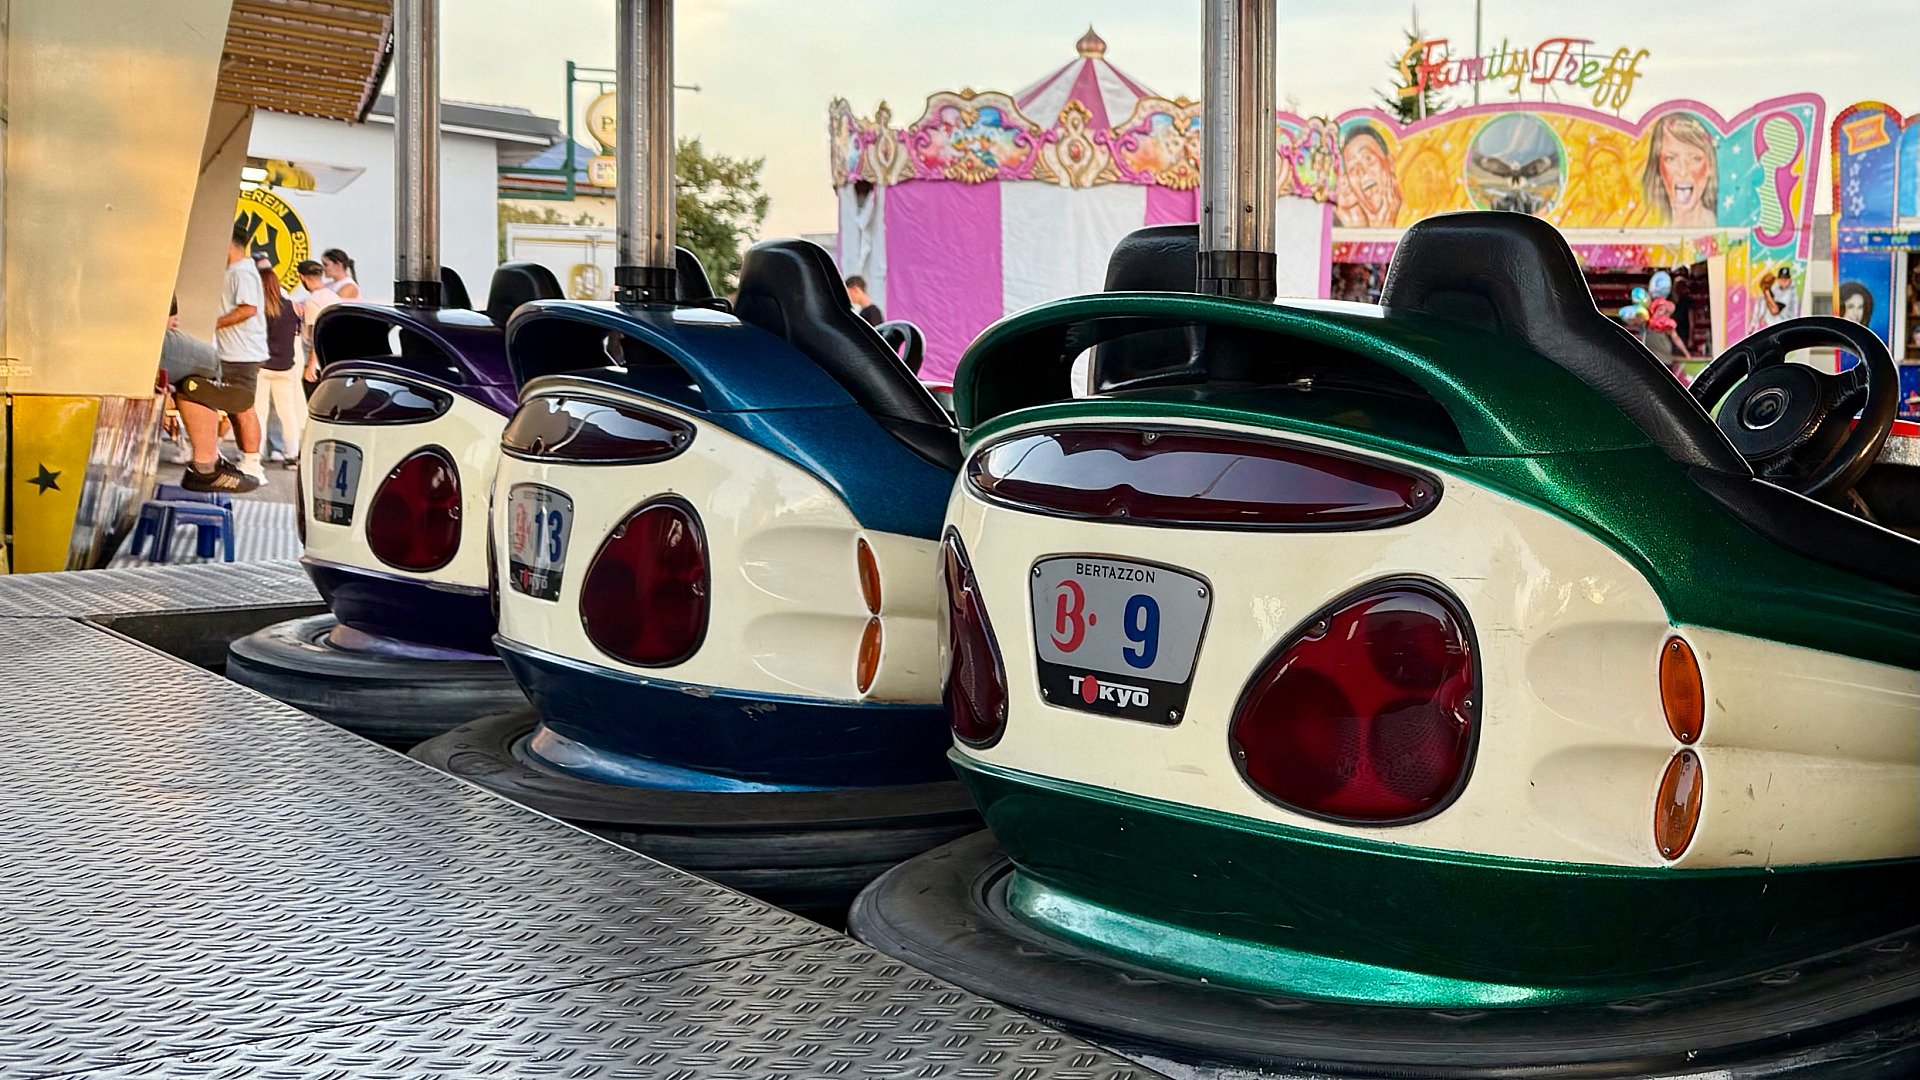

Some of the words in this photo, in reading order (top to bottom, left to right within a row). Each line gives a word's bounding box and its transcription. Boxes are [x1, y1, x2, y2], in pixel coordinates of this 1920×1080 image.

[1398, 38, 1529, 95] Family
[1530, 37, 1650, 109] Treff
[240, 189, 289, 217] EREIN
[336, 459, 348, 498] 4
[535, 509, 563, 563] 13
[1076, 562, 1156, 584] BERTAZZON
[1122, 593, 1161, 670] 9
